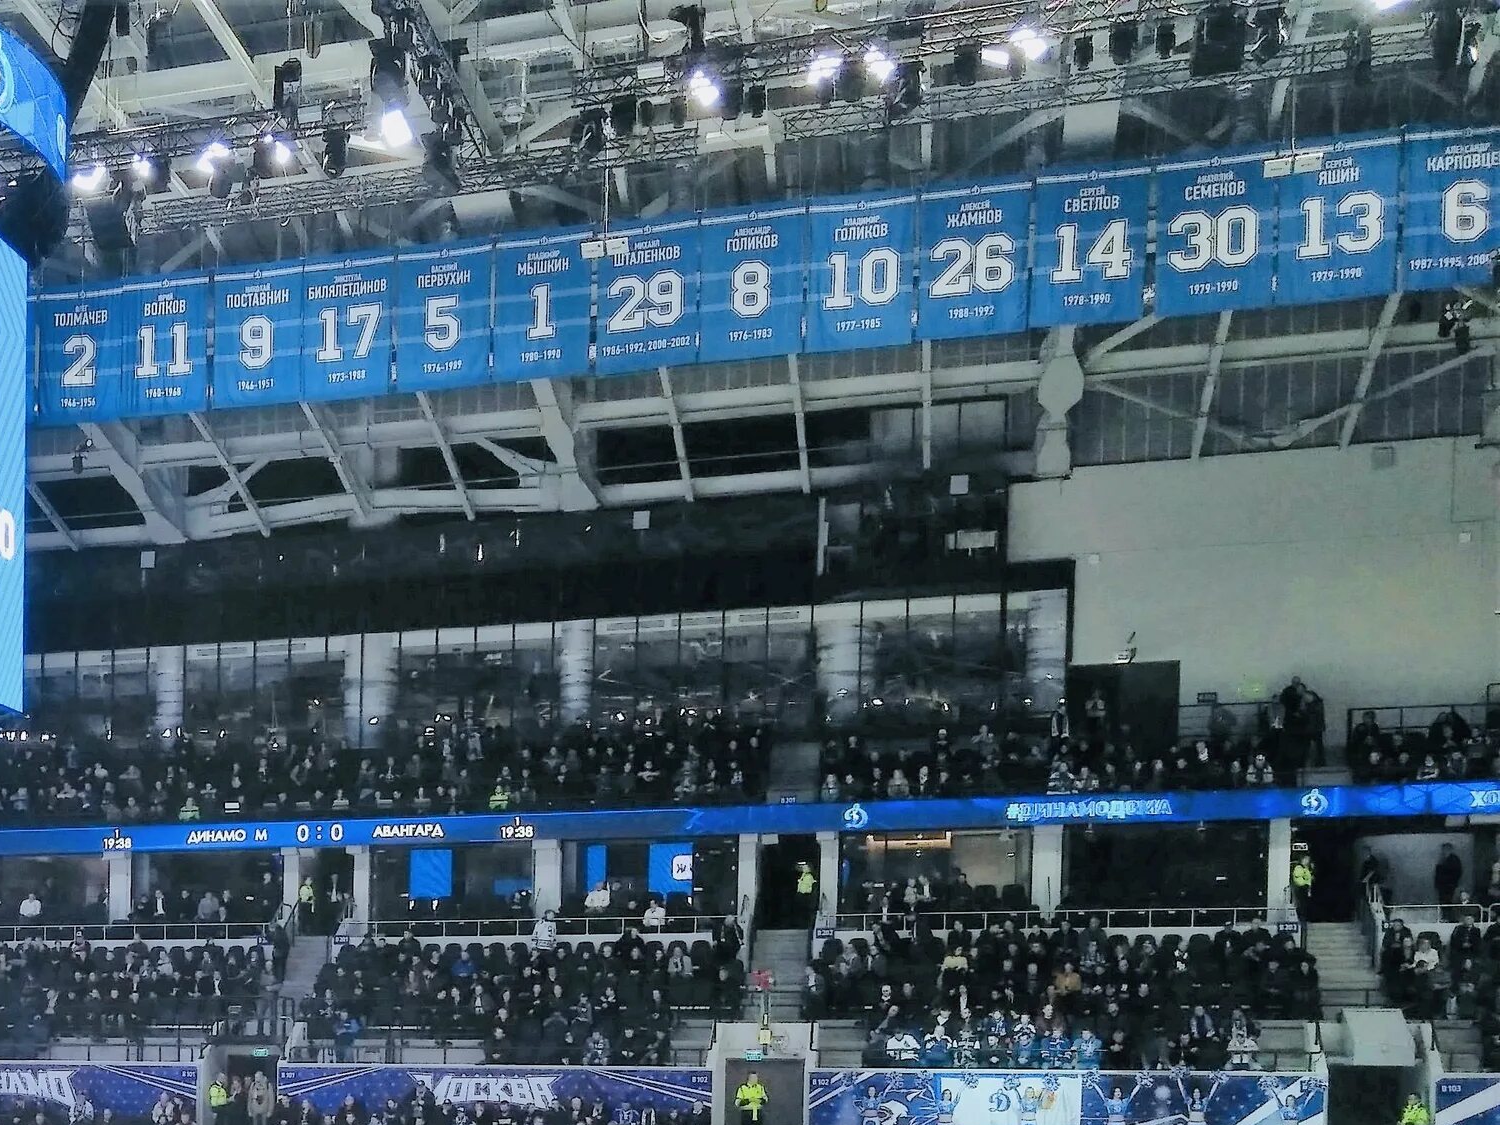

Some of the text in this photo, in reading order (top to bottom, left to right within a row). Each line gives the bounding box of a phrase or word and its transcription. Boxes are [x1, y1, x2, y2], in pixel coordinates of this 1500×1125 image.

[1318, 166, 1360, 186] ЯШИН
[1184, 180, 1246, 201] СЕМЕНОВ
[1064, 195, 1120, 213] СВЕТЛОВ
[1441, 179, 1490, 243] 6
[946, 209, 1002, 228] ЖАМНОВ
[1296, 191, 1384, 260] 13
[726, 234, 779, 253] ГОЛИКОВ
[834, 223, 888, 242] ГОЛИКОВ
[1168, 205, 1259, 272] 30
[613, 245, 681, 267] ШТАЛЕНКОВ
[1050, 218, 1134, 284] 14
[517, 258, 570, 276] МЫШКИН
[929, 233, 1016, 298] 26
[308, 278, 388, 300] БИЛЯЛЕТДИНОВ
[417, 270, 471, 288] ПЕРВУХИН
[730, 260, 771, 319] 8
[823, 247, 900, 310] 10
[144, 299, 186, 317] ВОЛКОВ
[226, 289, 289, 308] ПОСТАВНИН
[607, 270, 684, 334] 29
[54, 309, 108, 327] ТОЛМАЧЕВ
[425, 295, 460, 351] 5
[527, 283, 556, 341] 1
[239, 315, 273, 370] 9
[316, 302, 383, 363] 17
[61, 334, 96, 387] 2
[135, 322, 193, 379] 11
[187, 824, 445, 844] ДИНАМО М 0 0 АВАНГАРД
[501, 825, 534, 839] 19:38
[103, 837, 132, 850] 19:38
